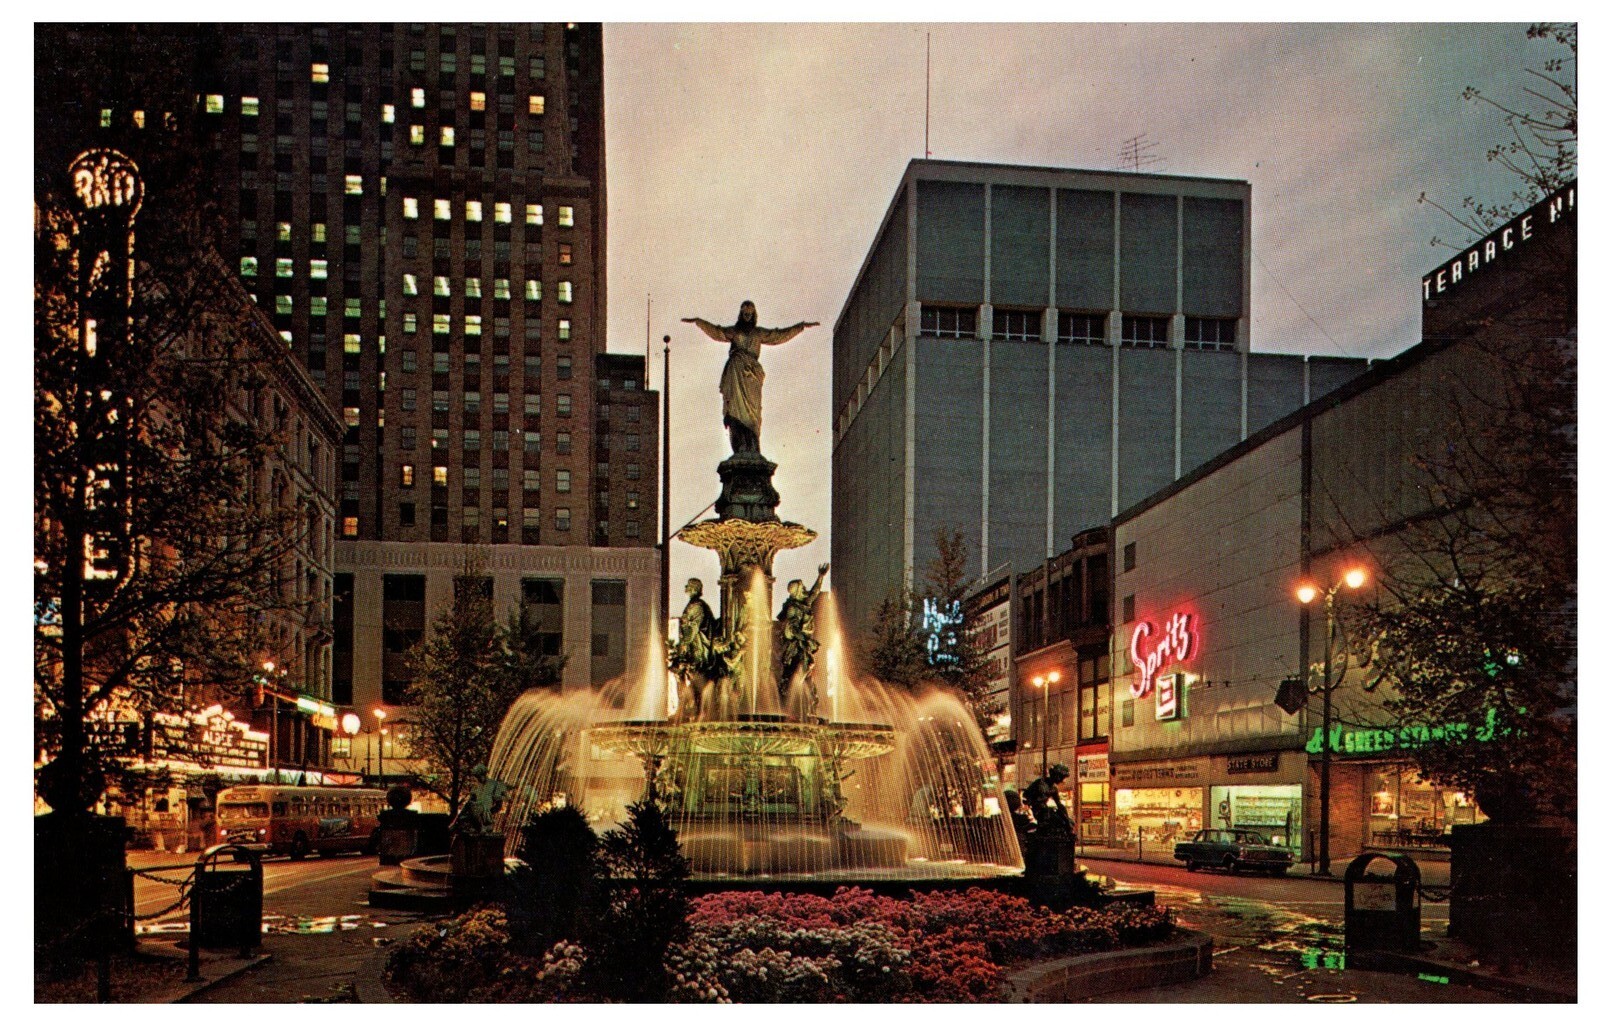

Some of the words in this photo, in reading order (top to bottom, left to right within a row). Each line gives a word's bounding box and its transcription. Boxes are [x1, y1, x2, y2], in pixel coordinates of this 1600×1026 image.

[1423, 214, 1533, 300] TERRACE
[1130, 612, 1194, 699] Spritz
[1344, 729, 1395, 752] GREEN
